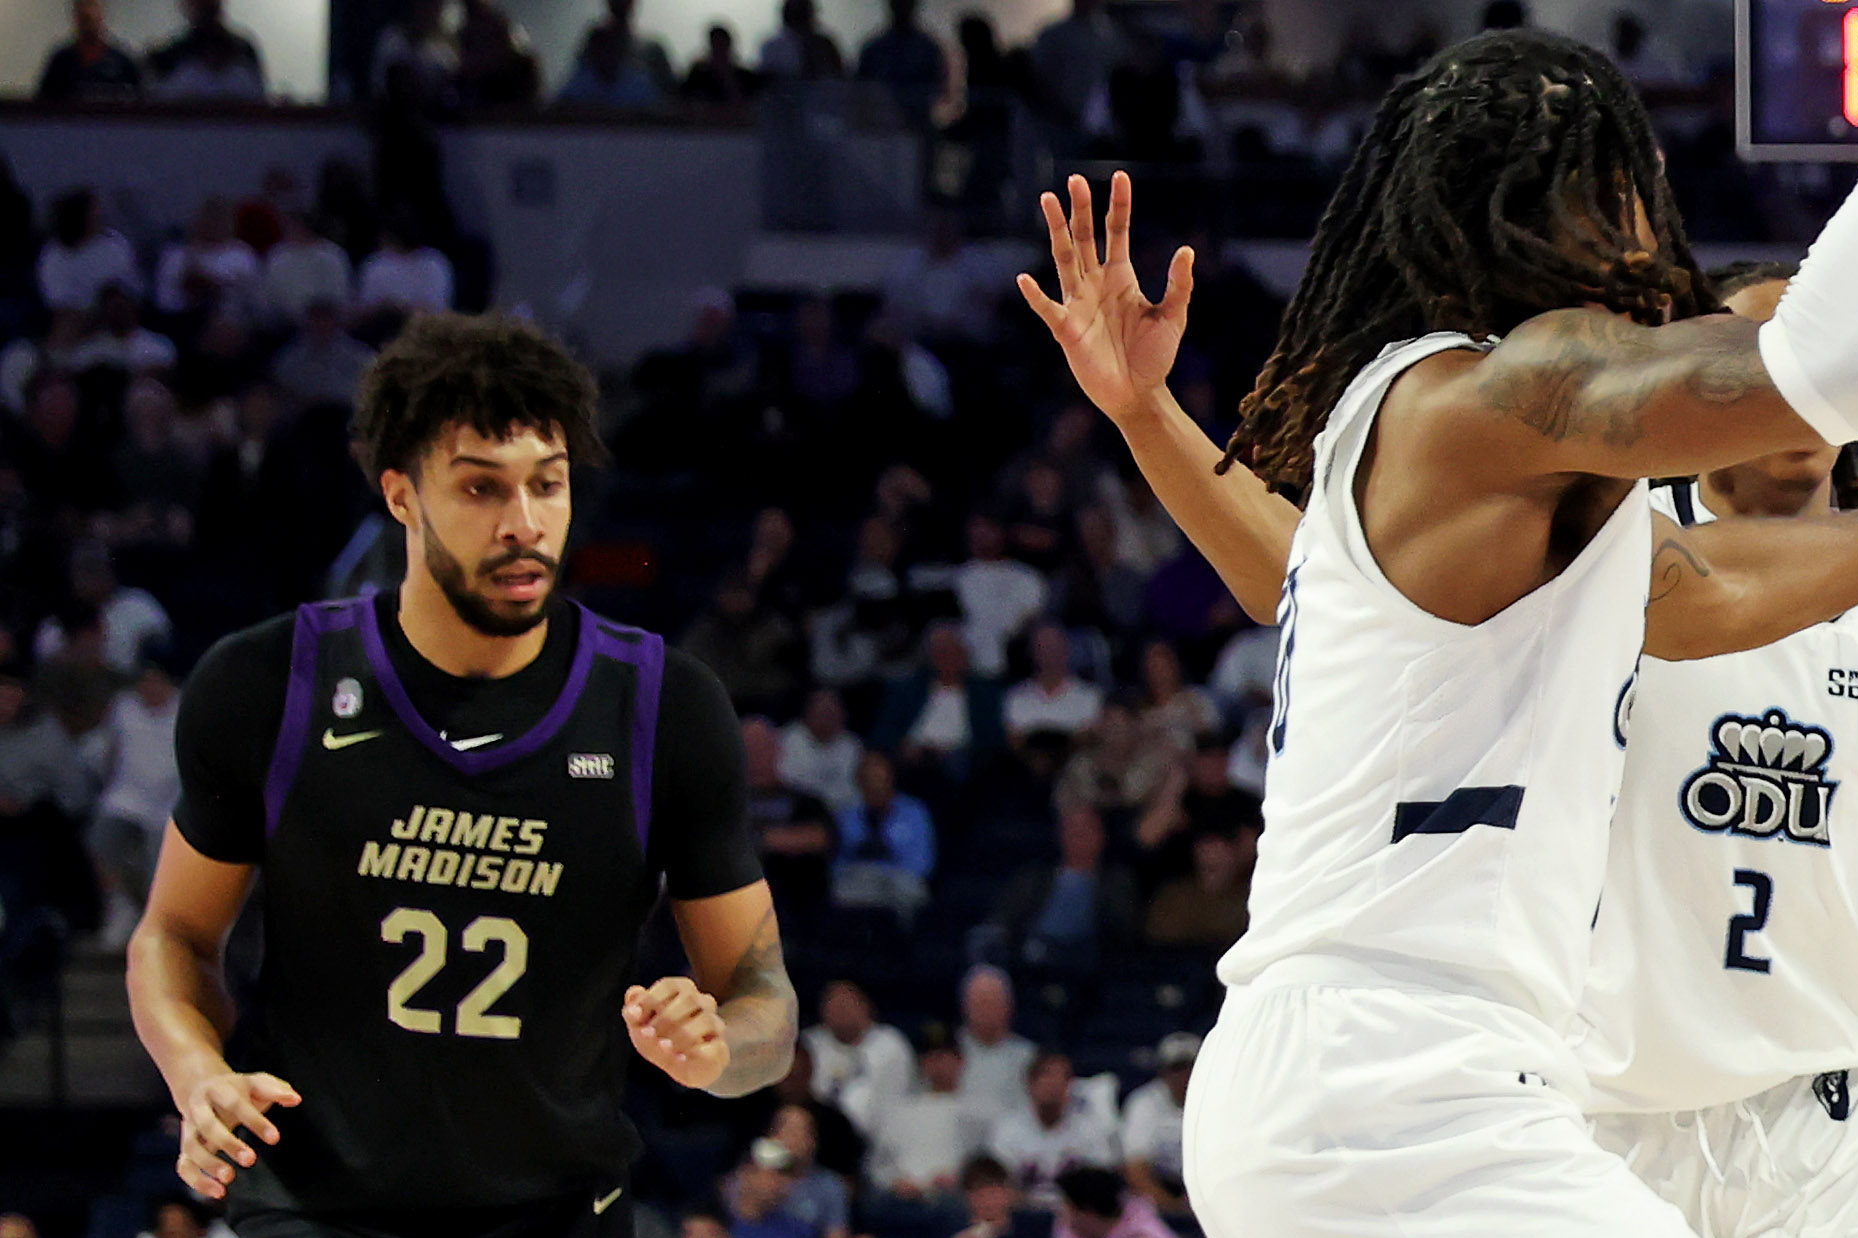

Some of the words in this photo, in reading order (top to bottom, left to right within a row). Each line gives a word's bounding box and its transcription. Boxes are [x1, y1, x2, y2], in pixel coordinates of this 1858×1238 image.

[391, 804, 549, 855] JAMES
[1679, 770, 1839, 846] ODU
[357, 840, 564, 897] MADISON
[1724, 867, 1774, 975] 2
[380, 906, 529, 1040] 22
